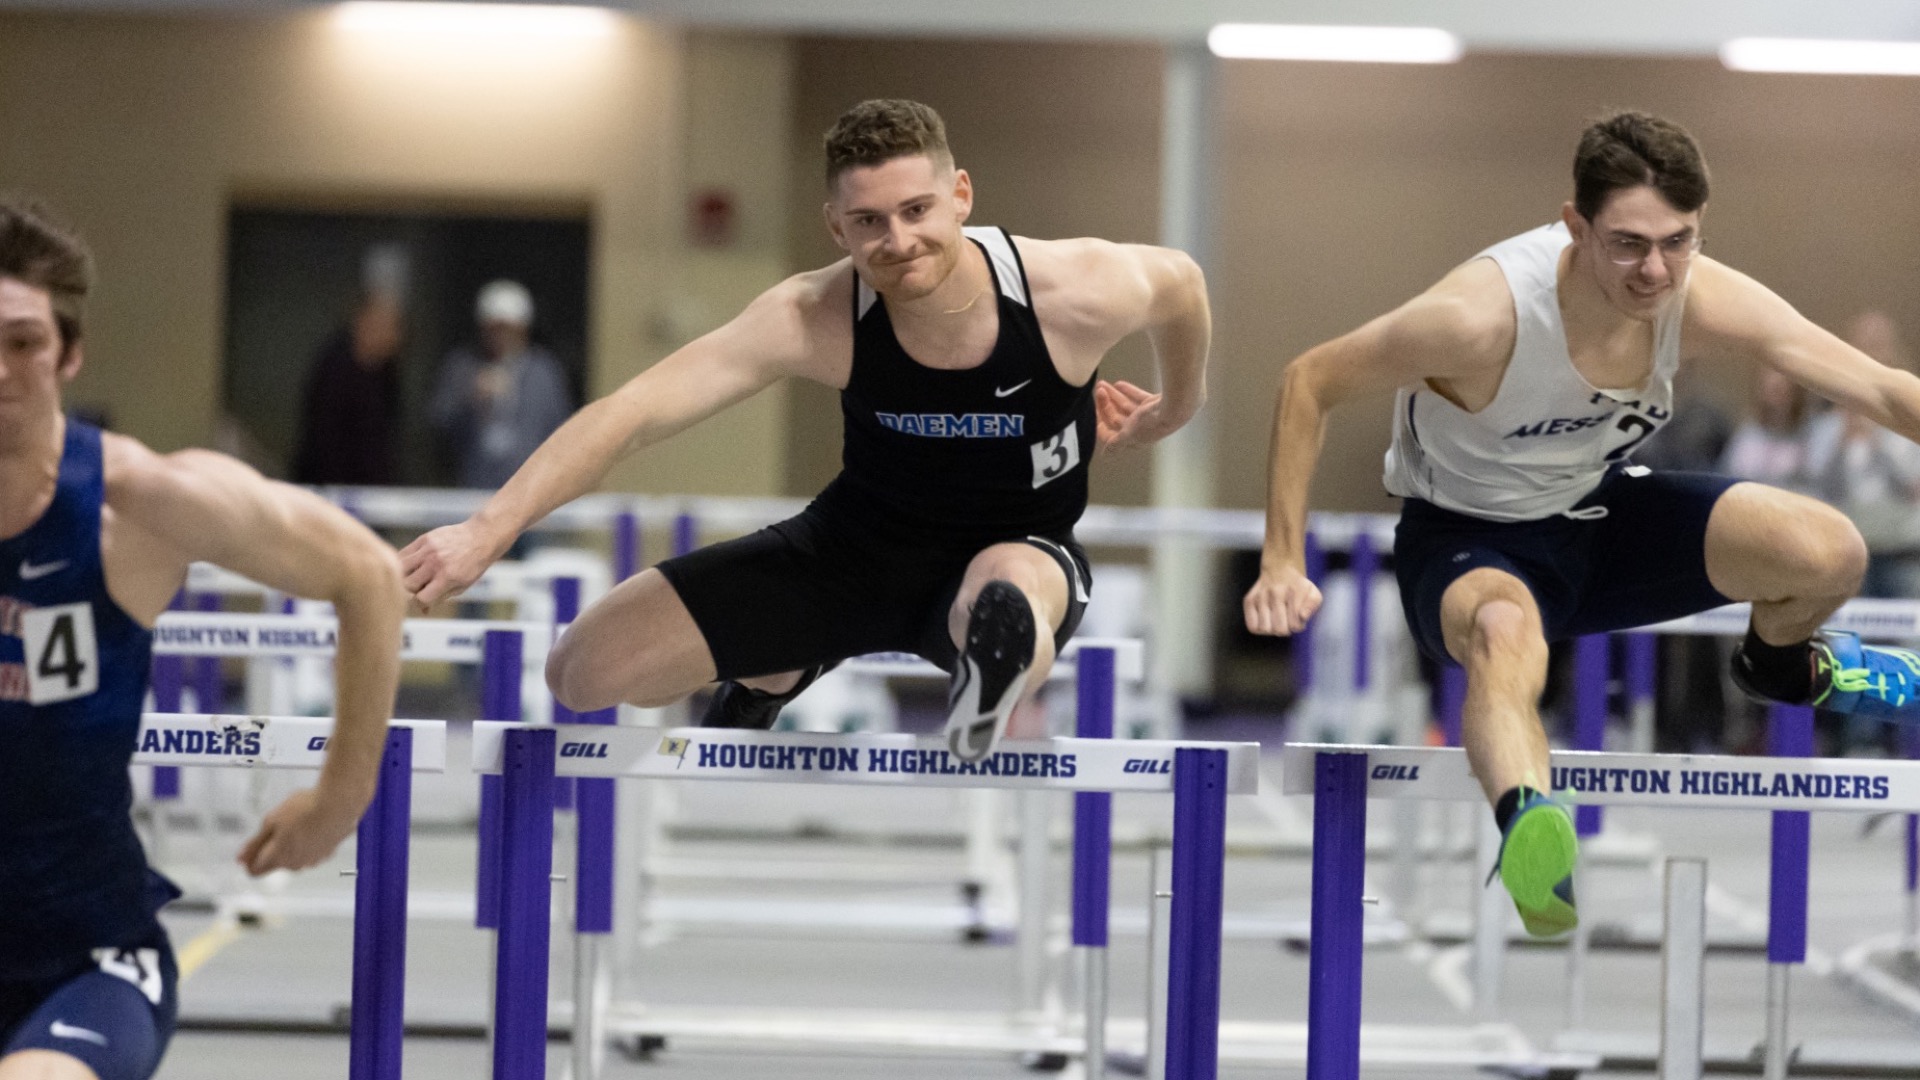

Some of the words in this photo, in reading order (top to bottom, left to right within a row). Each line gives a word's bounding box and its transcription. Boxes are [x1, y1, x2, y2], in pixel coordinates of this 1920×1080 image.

[876, 412, 1024, 438] DAEMEN
[1603, 414, 1655, 461] 2
[1042, 430, 1068, 478] 3
[39, 613, 85, 688] 4
[137, 729, 262, 756] ANDERS
[560, 742, 608, 758] GILL
[698, 743, 859, 772] HOUGHTON
[868, 748, 1077, 778] HIGHLANDERS
[1123, 759, 1171, 774] GILL
[1371, 765, 1419, 780] GILL
[1551, 767, 1671, 794] UGHTON
[1680, 770, 1889, 800] HIGHLANDERS
